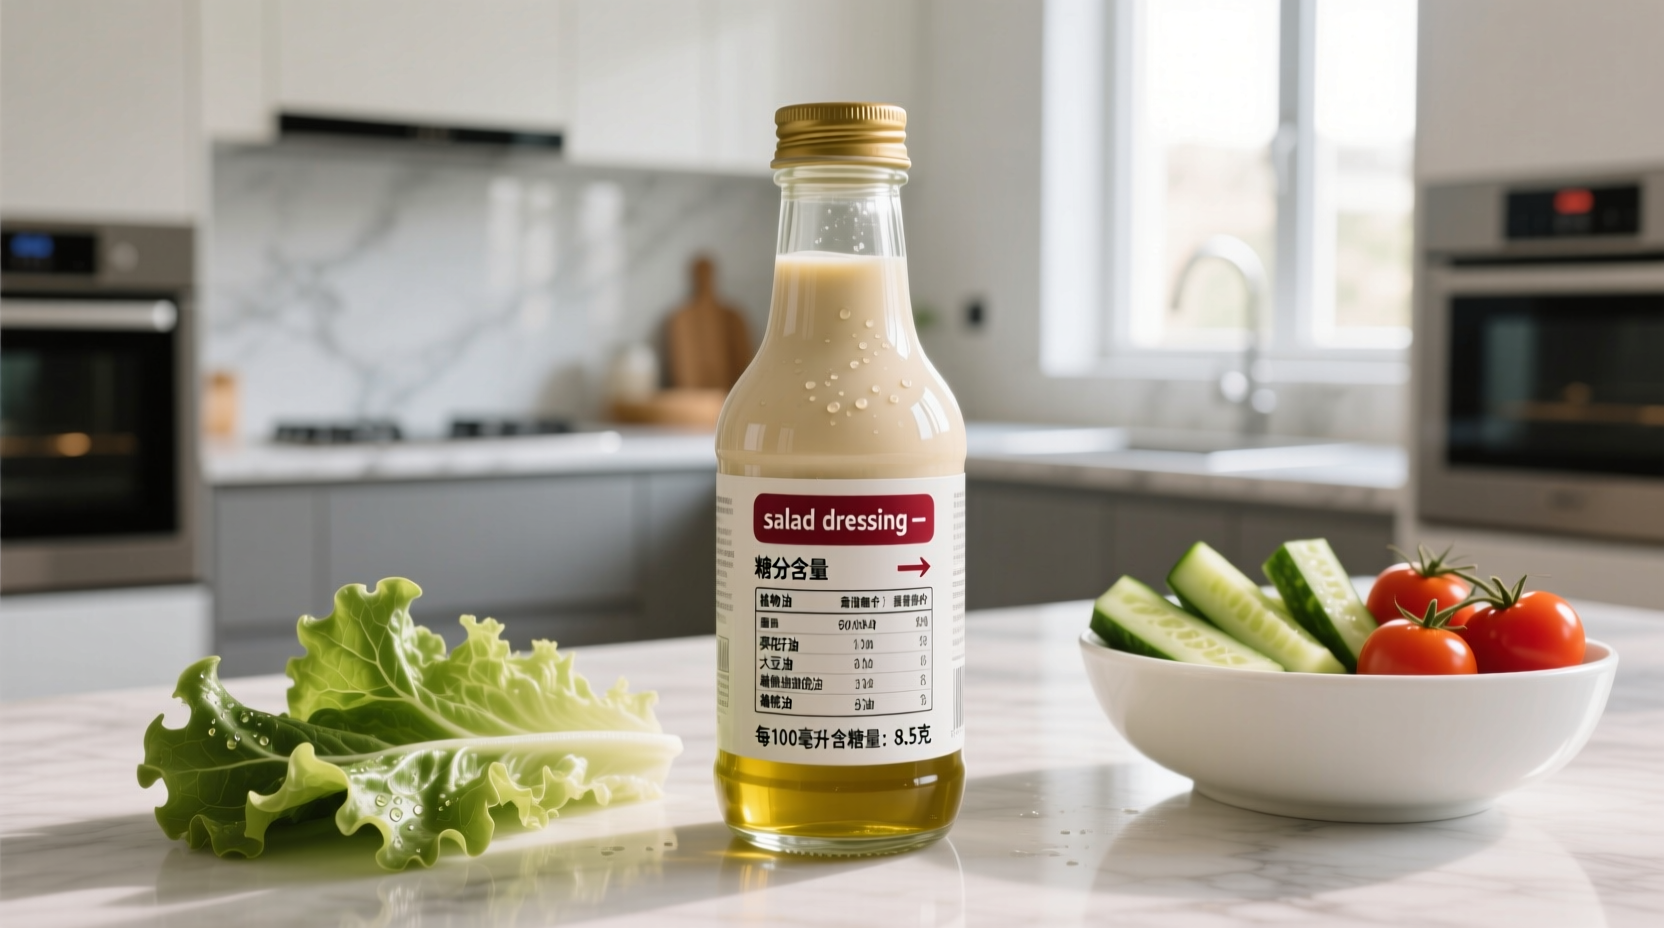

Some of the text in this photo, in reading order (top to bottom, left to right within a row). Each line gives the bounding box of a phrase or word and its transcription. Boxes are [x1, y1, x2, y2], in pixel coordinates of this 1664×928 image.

[763, 507, 815, 531] salad
[754, 554, 829, 581] 糖分含量
